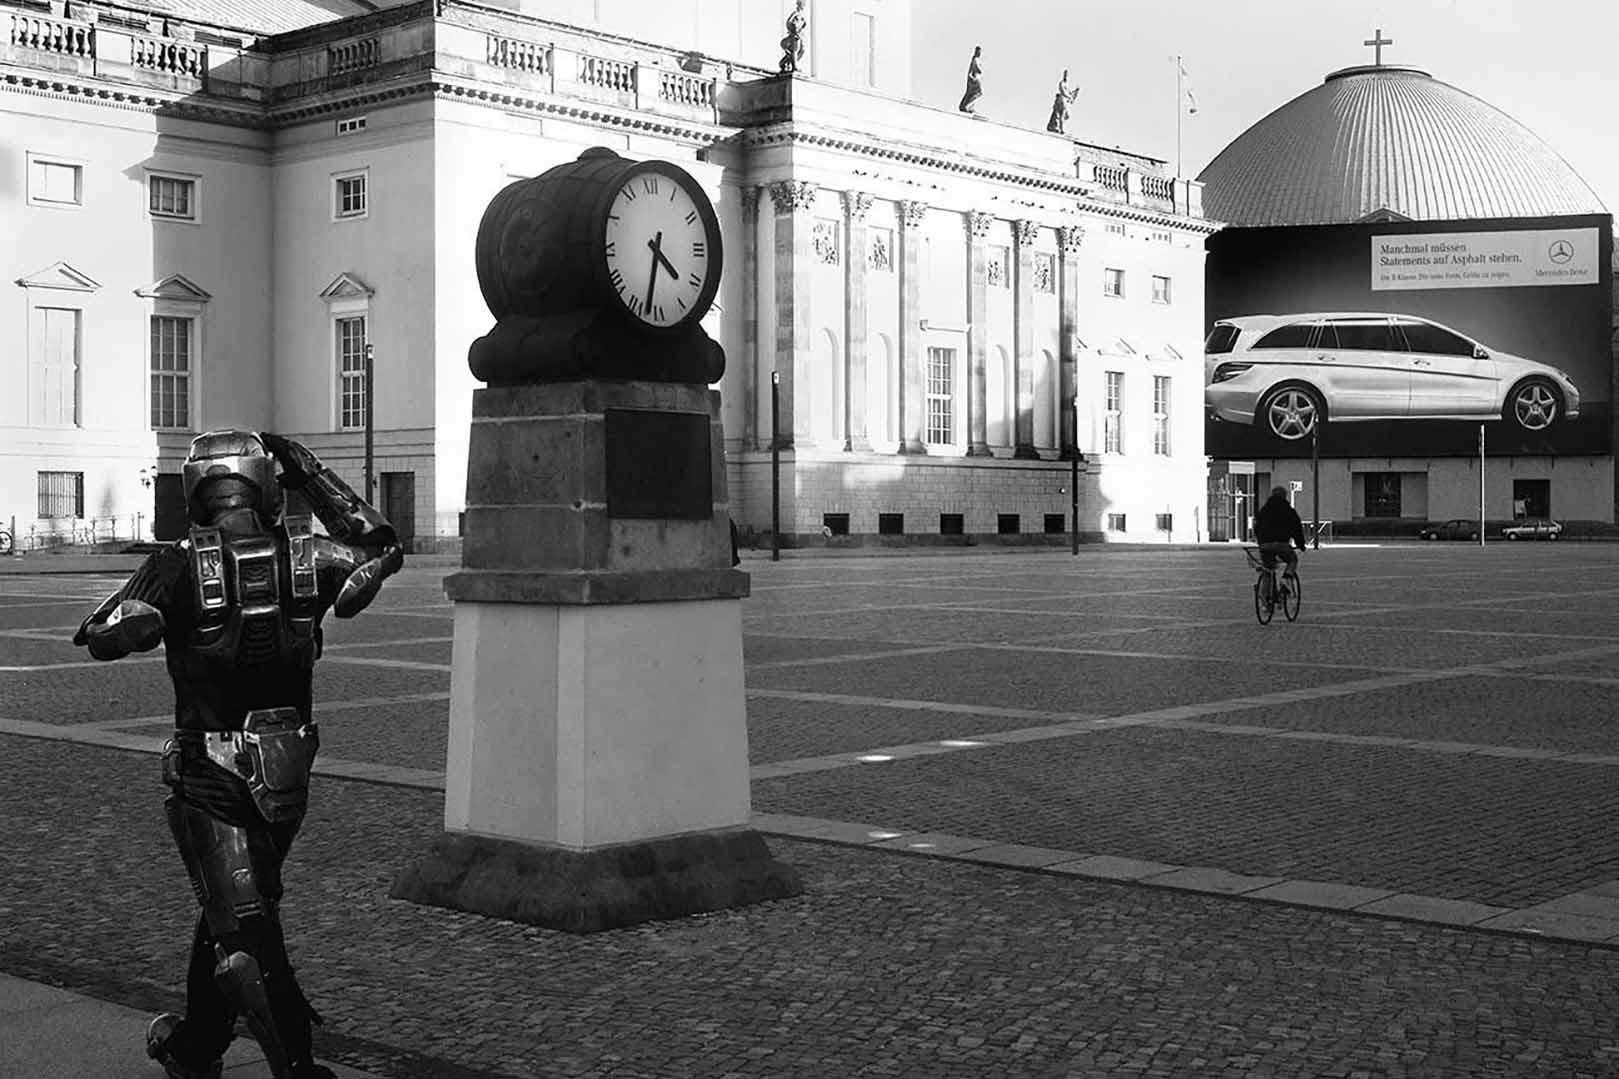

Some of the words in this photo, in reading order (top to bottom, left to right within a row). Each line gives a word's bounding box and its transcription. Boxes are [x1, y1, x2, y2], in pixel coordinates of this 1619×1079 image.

[693, 243, 704, 257] III
[1380, 243, 1429, 255] Manchmal
[1431, 242, 1467, 253] müssen
[1380, 255, 1431, 266] Statements
[1433, 254, 1449, 264] auf
[1451, 253, 1487, 266] Asphalt
[1489, 252, 1522, 263] stehen.
